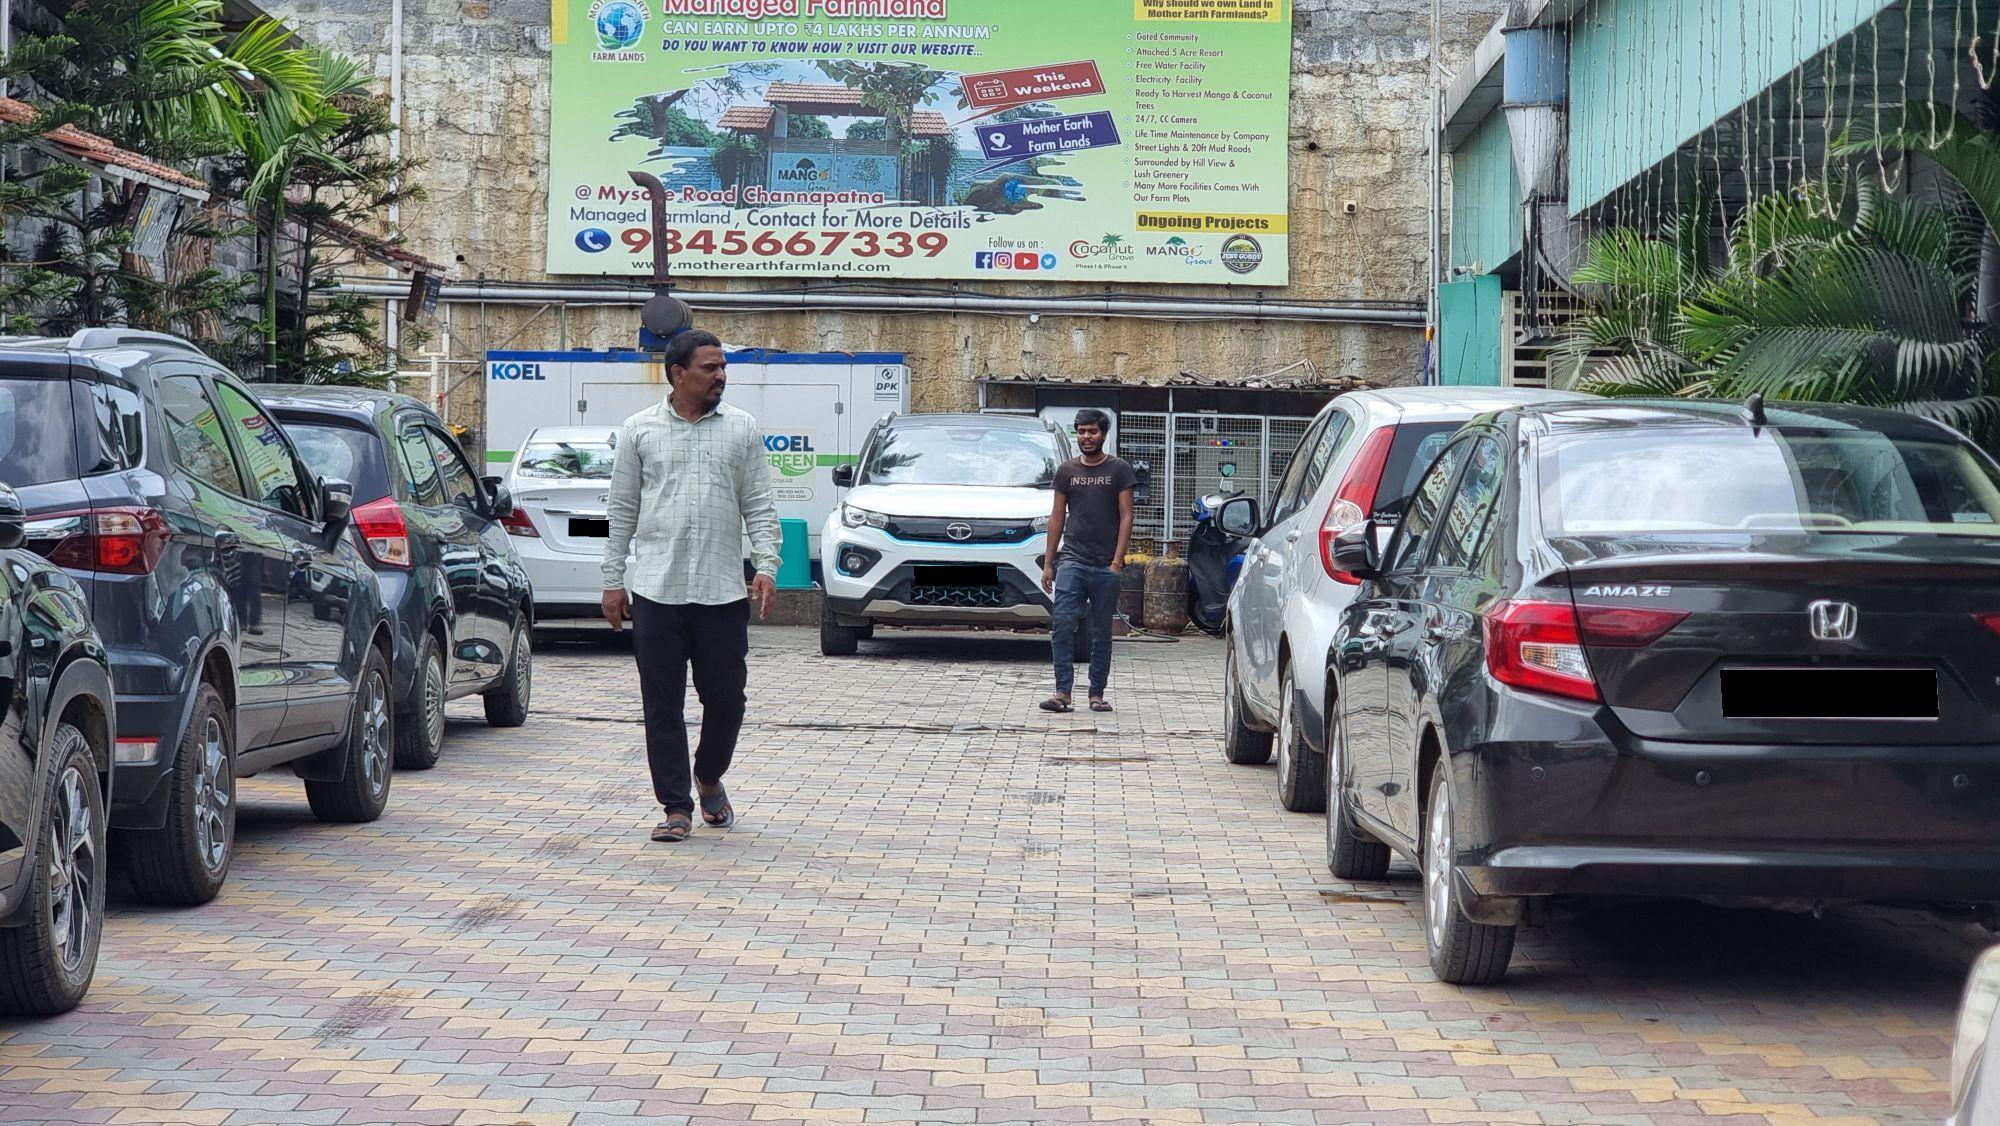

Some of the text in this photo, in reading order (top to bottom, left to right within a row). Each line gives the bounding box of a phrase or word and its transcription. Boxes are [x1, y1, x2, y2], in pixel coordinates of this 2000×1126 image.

[1166, 0, 1199, 8] should
[1239, 0, 1262, 8] Land
[1148, 9, 1268, 20] Mother Earth Farmlands?
[663, 20, 699, 35] CAN
[704, 21, 749, 36] EARN
[754, 22, 799, 36] UPTO
[828, 23, 883, 37] LAKHS
[888, 23, 917, 38] PER
[1137, 32, 1198, 43] Gated Community
[663, 40, 679, 51] DO
[684, 40, 708, 51] YOU
[712, 40, 748, 52] WANT
[752, 41, 766, 52] TO
[770, 41, 808, 53] KNOW
[812, 42, 842, 54] HOW
[857, 43, 888, 55] VISIT
[892, 43, 917, 55] OUR
[1137, 48, 1170, 57] Attached
[1180, 49, 1197, 57] Acre
[1200, 49, 1223, 57] Resort
[593, 52, 645, 62] FARM LANDS
[1136, 61, 1206, 71] Free Water Facility
[1033, 71, 1066, 83] This
[1136, 75, 1202, 86] Electricity Facility
[1014, 78, 1092, 96] Weekend
[1136, 89, 1272, 101] Ready To Harvest Mango & Coconut
[1136, 101, 1154, 110] Trees
[1160, 115, 1169, 123] CC
[1171, 115, 1197, 124] Camera
[1023, 116, 1093, 136] Mother Earth
[1135, 130, 1269, 142] Life Time Maintenance by Company
[1029, 133, 1091, 152] Farm Lands
[1135, 143, 1251, 154] Street Lights & 20ft Mud Roads
[1135, 158, 1235, 169] Surrounded by Hill View &
[1134, 170, 1189, 181] Lush Greenery
[1134, 182, 1259, 192] Many More Facilities Comes With
[575, 184, 885, 206] @ Mysoe Road Channapatna
[1134, 193, 1190, 203] Our Farm Plots
[570, 206, 647, 224] Managed
[665, 210, 731, 225] armland
[747, 209, 816, 227] Contact
[822, 208, 848, 227] for
[855, 210, 903, 228] More
[910, 211, 971, 230] Details
[1138, 214, 1269, 229] Ongoing Projects
[989, 236, 1014, 249] Follow
[1017, 239, 1025, 249] us
[1028, 240, 1038, 249] on
[1069, 239, 1134, 259] Coconut
[1109, 253, 1134, 261] Grove
[1186, 255, 1213, 266] Grove
[632, 259, 891, 273] ww.motherearthfarmland.com
[492, 363, 545, 381] KOEL
[876, 382, 898, 391] DPK
[1071, 475, 1112, 486] INSPIRE
[1584, 585, 1672, 597] AMAZE
